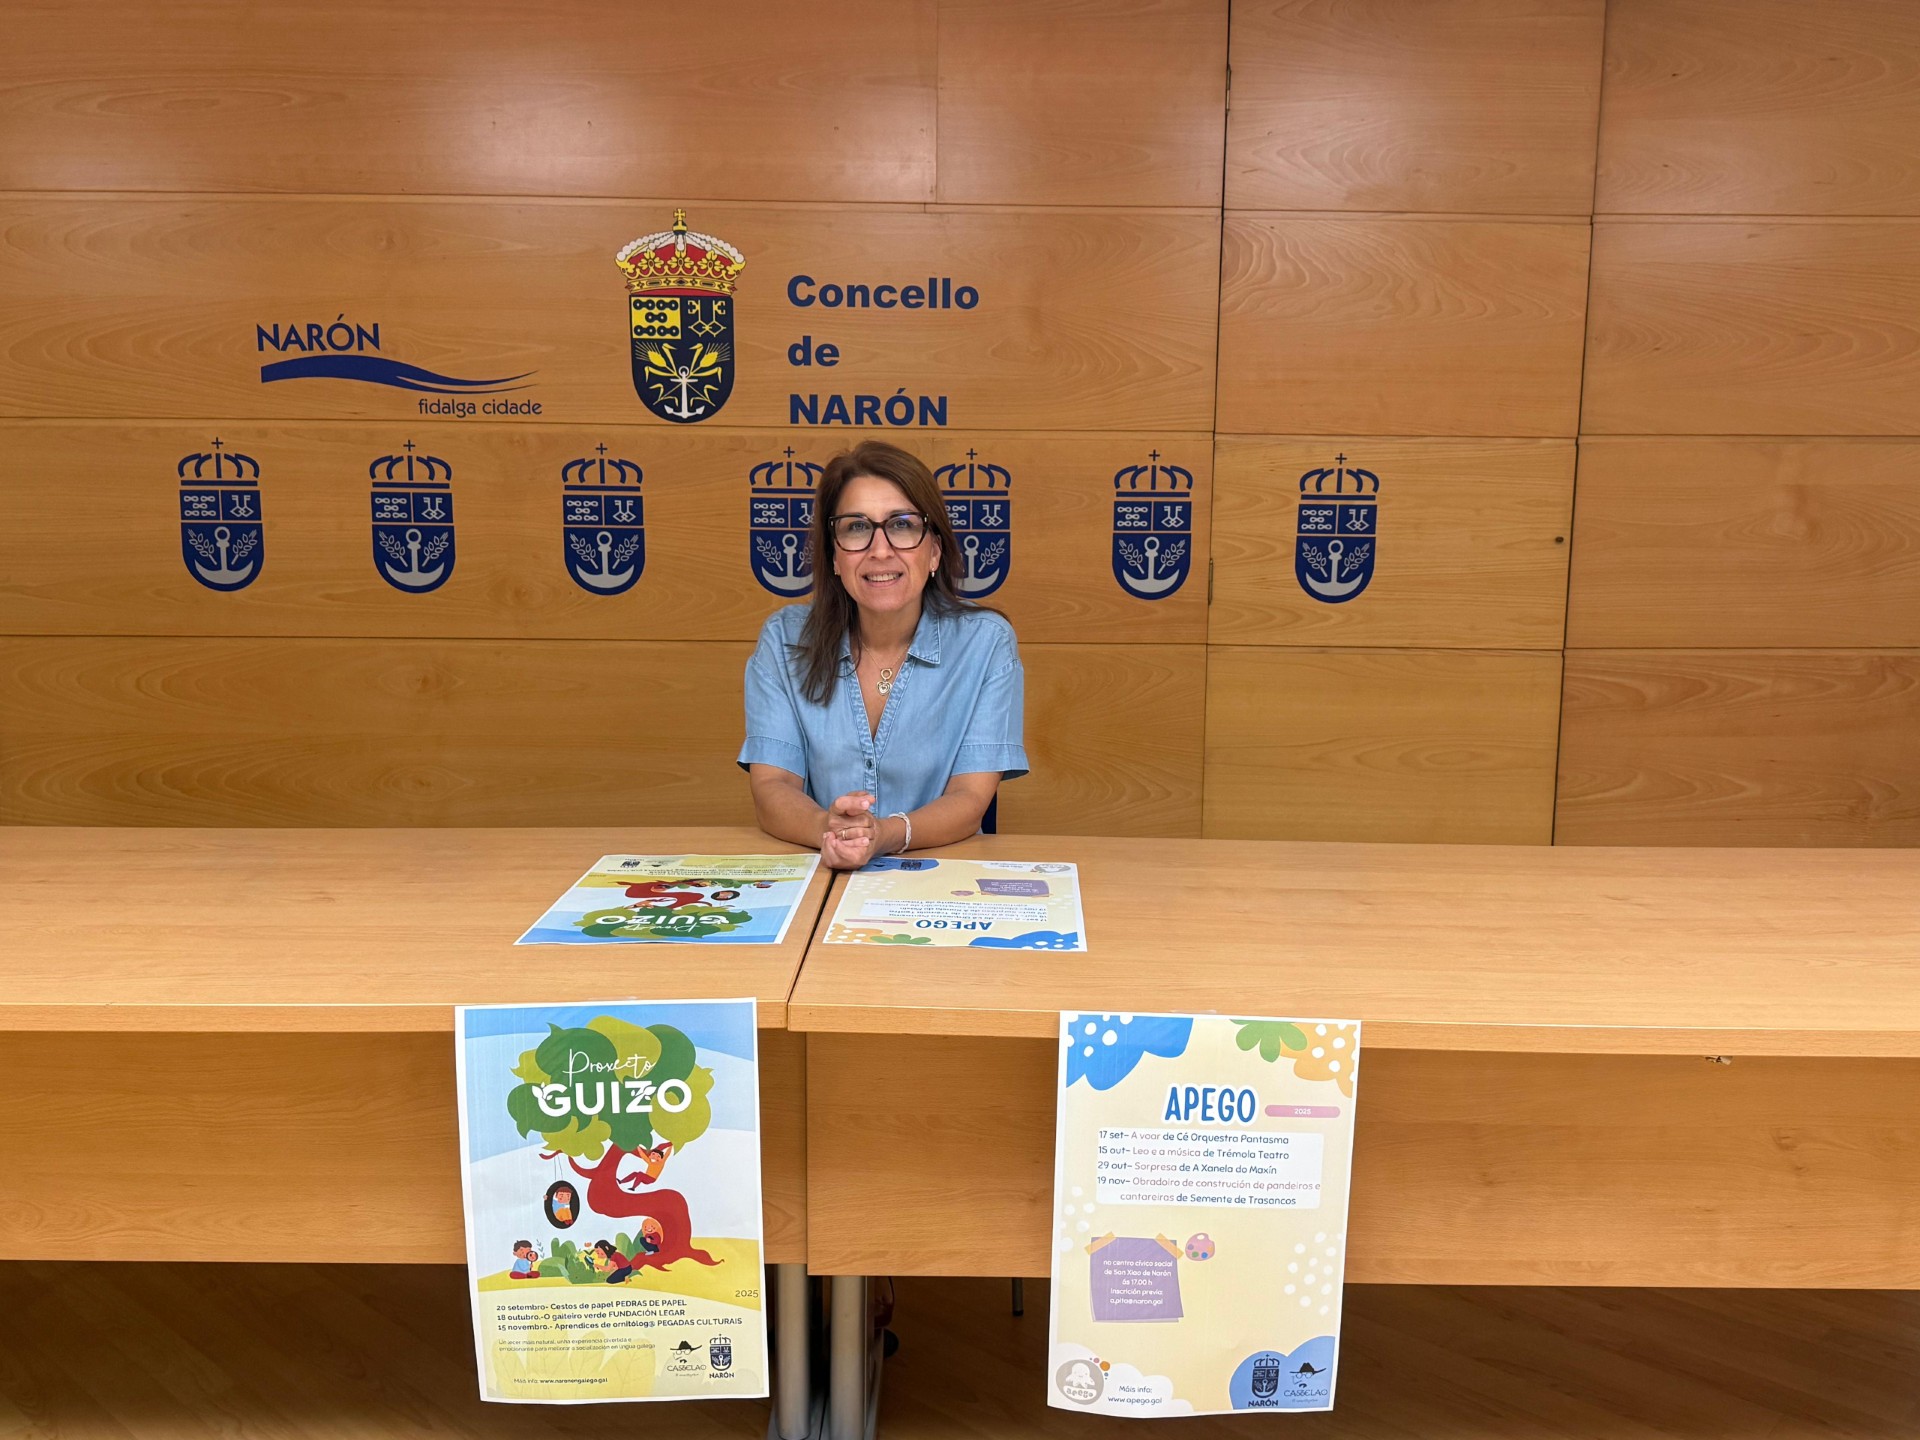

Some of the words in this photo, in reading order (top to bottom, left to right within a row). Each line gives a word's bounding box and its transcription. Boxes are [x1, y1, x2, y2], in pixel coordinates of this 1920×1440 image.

[787, 275, 979, 309] Concello
[256, 313, 380, 351] NARÓN
[787, 336, 840, 367] de
[418, 398, 477, 419] fidalga
[482, 398, 542, 415] cidade
[789, 388, 948, 426] NARÓN
[595, 915, 730, 925] GUIZO
[915, 919, 993, 930] APEGO
[562, 1048, 657, 1088] Proxecto
[532, 1078, 692, 1117] GUIZO
[1164, 1086, 1256, 1123] APEGO
[1099, 1130, 1108, 1139] 17
[1131, 1131, 1138, 1140] A
[1162, 1132, 1175, 1141] de
[1176, 1132, 1189, 1141] Cé
[1191, 1133, 1239, 1144] Orquestra
[1240, 1134, 1289, 1145] Pantasma
[1098, 1146, 1107, 1154] 15
[1132, 1147, 1150, 1155] Leo
[1167, 1148, 1201, 1157] música
[1203, 1149, 1215, 1157] de
[1217, 1149, 1256, 1159] Trémola
[1258, 1150, 1290, 1160] Teatro
[1098, 1161, 1109, 1170] 29
[1134, 1162, 1177, 1172] Sorpresa
[1179, 1163, 1191, 1172] de
[1192, 1164, 1200, 1172] A
[1201, 1164, 1234, 1173] Xanela
[1235, 1165, 1248, 1174] do
[1249, 1165, 1277, 1174] Maxín
[1097, 1176, 1107, 1184] 19
[1132, 1177, 1180, 1186] Obradoiro
[1182, 1179, 1194, 1187] de
[1196, 1180, 1250, 1189] construción
[1252, 1181, 1264, 1190] de
[1267, 1181, 1313, 1191] pandeiros
[1176, 1193, 1188, 1202] de
[1190, 1194, 1232, 1203] Semente
[1234, 1195, 1246, 1204] de
[1249, 1196, 1296, 1205] Trasancos
[735, 1289, 759, 1298] 2025
[507, 1303, 548, 1311] setembro-
[591, 1301, 614, 1310] papel
[649, 1299, 660, 1307] DE
[552, 1312, 582, 1322] gaiteiro
[609, 1309, 657, 1318] FUNDACIÓN
[659, 1309, 685, 1317] LEGAR
[498, 1324, 507, 1332] 15
[554, 1322, 599, 1331] Aprendices
[657, 1319, 695, 1327] PEGADAS
[696, 1318, 743, 1326] CULTURAIS
[709, 1371, 735, 1379] NARÓN
[1066, 1387, 1094, 1398] apego
[1119, 1385, 1136, 1393] Máis
[1137, 1385, 1153, 1394] info:
[1107, 1396, 1163, 1406] www.apego.gal
[1248, 1398, 1279, 1407] NARÓN
